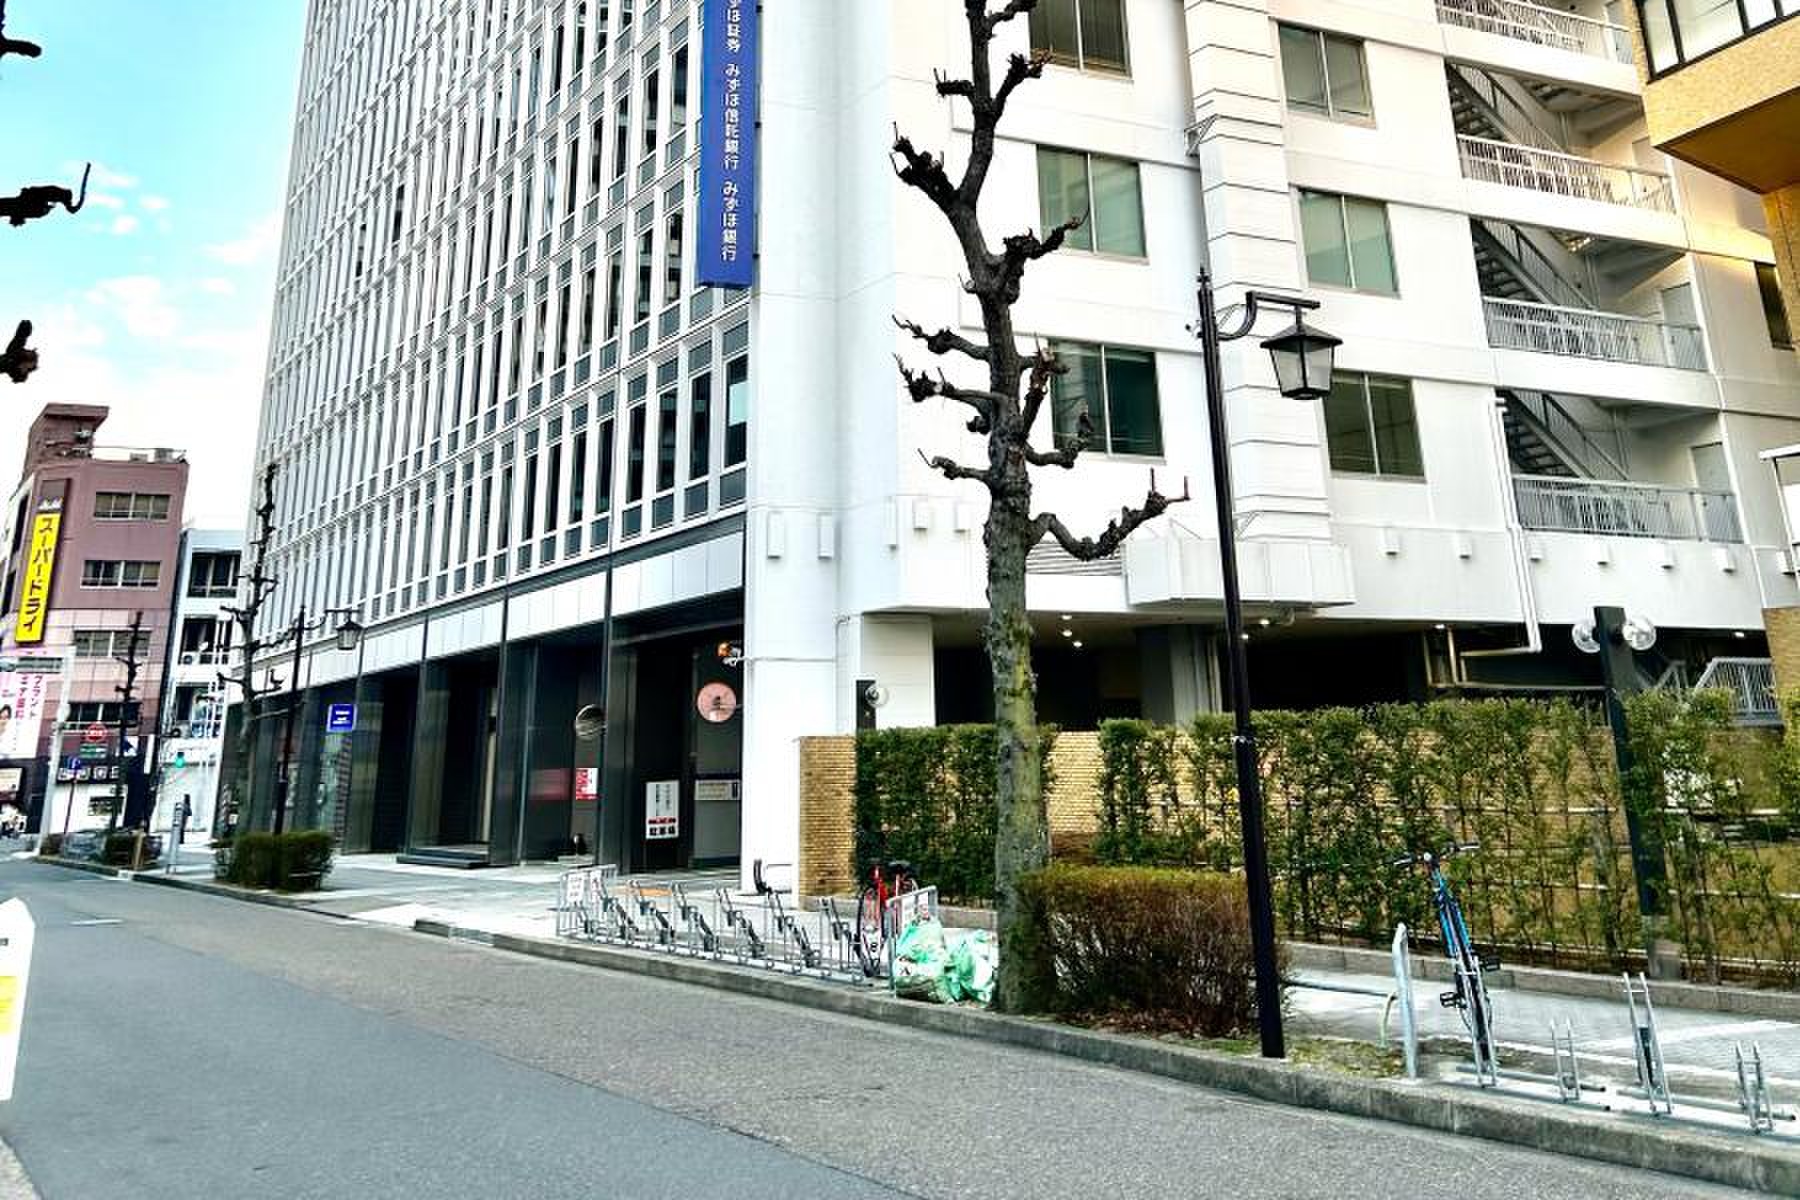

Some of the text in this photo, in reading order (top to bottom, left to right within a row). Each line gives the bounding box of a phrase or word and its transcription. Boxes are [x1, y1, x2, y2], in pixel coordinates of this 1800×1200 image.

[721, 181, 738, 261] みずほ銀行
[22, 517, 54, 632] スーパードライ
